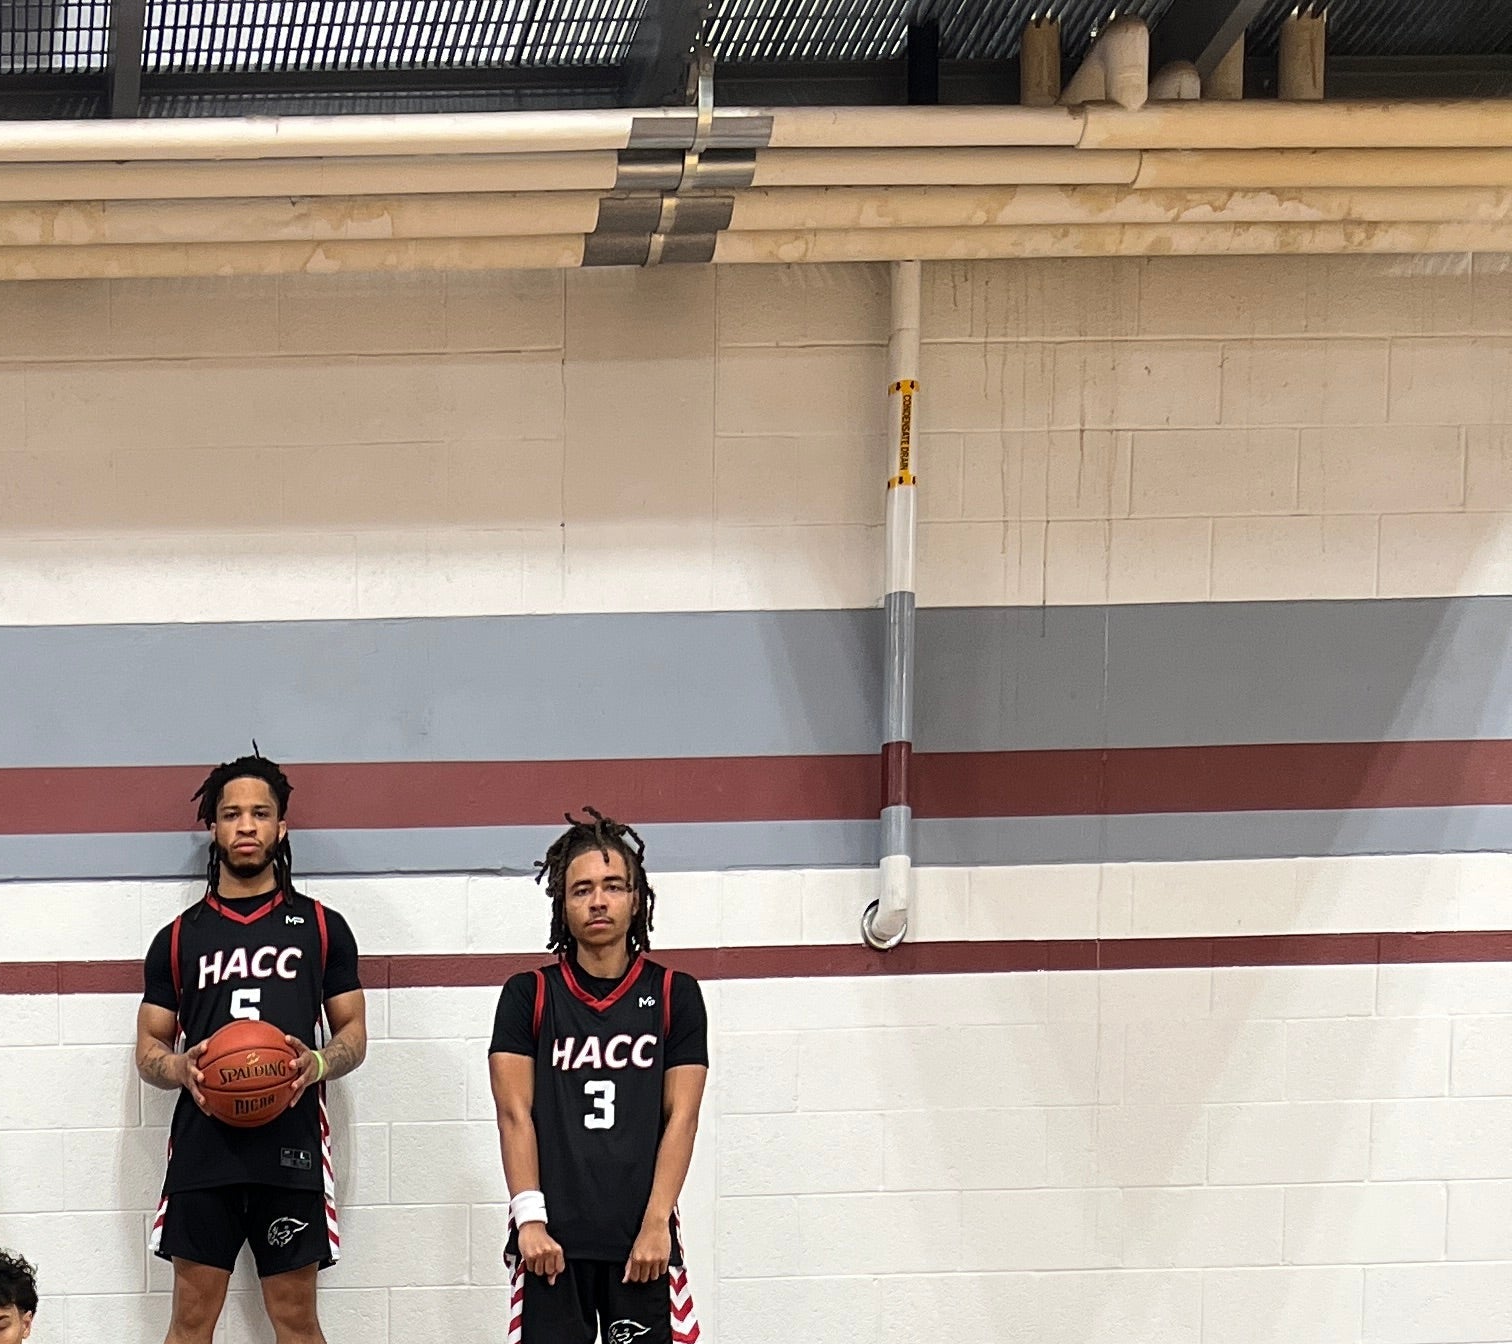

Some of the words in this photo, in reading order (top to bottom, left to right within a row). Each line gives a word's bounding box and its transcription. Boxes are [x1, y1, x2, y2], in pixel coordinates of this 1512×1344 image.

[197, 945, 302, 989] HACC
[551, 1033, 658, 1070] HACC
[219, 1060, 286, 1085] SPALDING
[583, 1079, 616, 1129] 3
